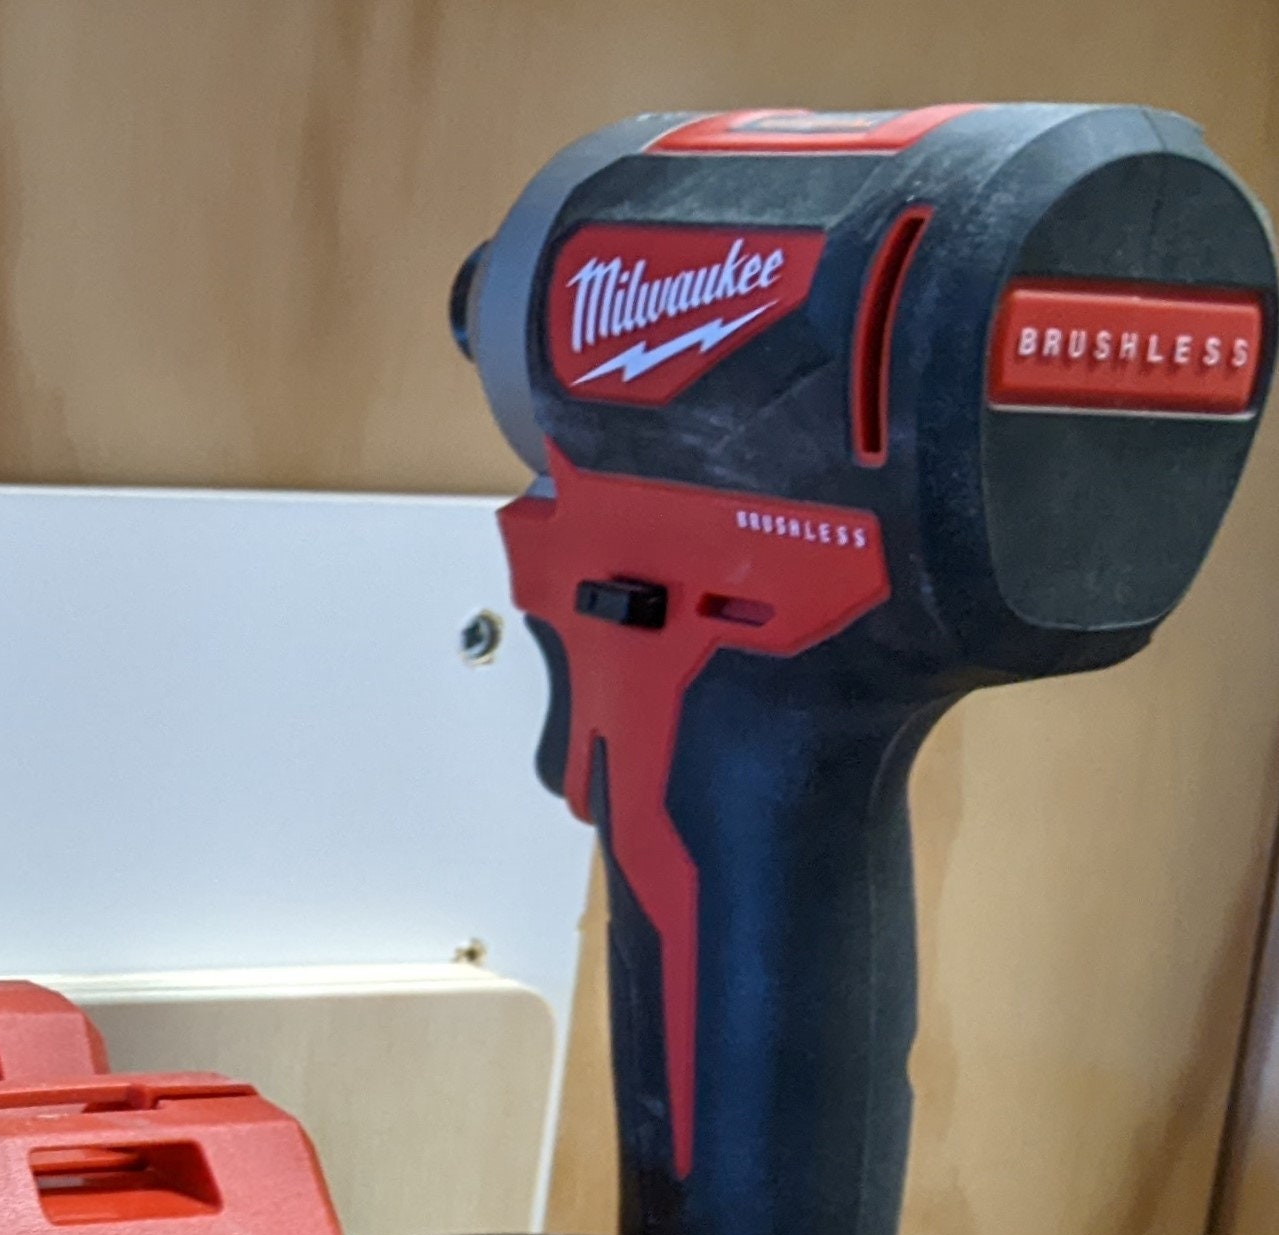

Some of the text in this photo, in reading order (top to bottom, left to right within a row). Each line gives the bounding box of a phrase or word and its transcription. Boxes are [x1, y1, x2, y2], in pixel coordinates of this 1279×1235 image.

[566, 238, 784, 353] Milwaukee
[1018, 326, 1249, 367] BRUSHLESS
[736, 511, 866, 547] BRUSHLESS
